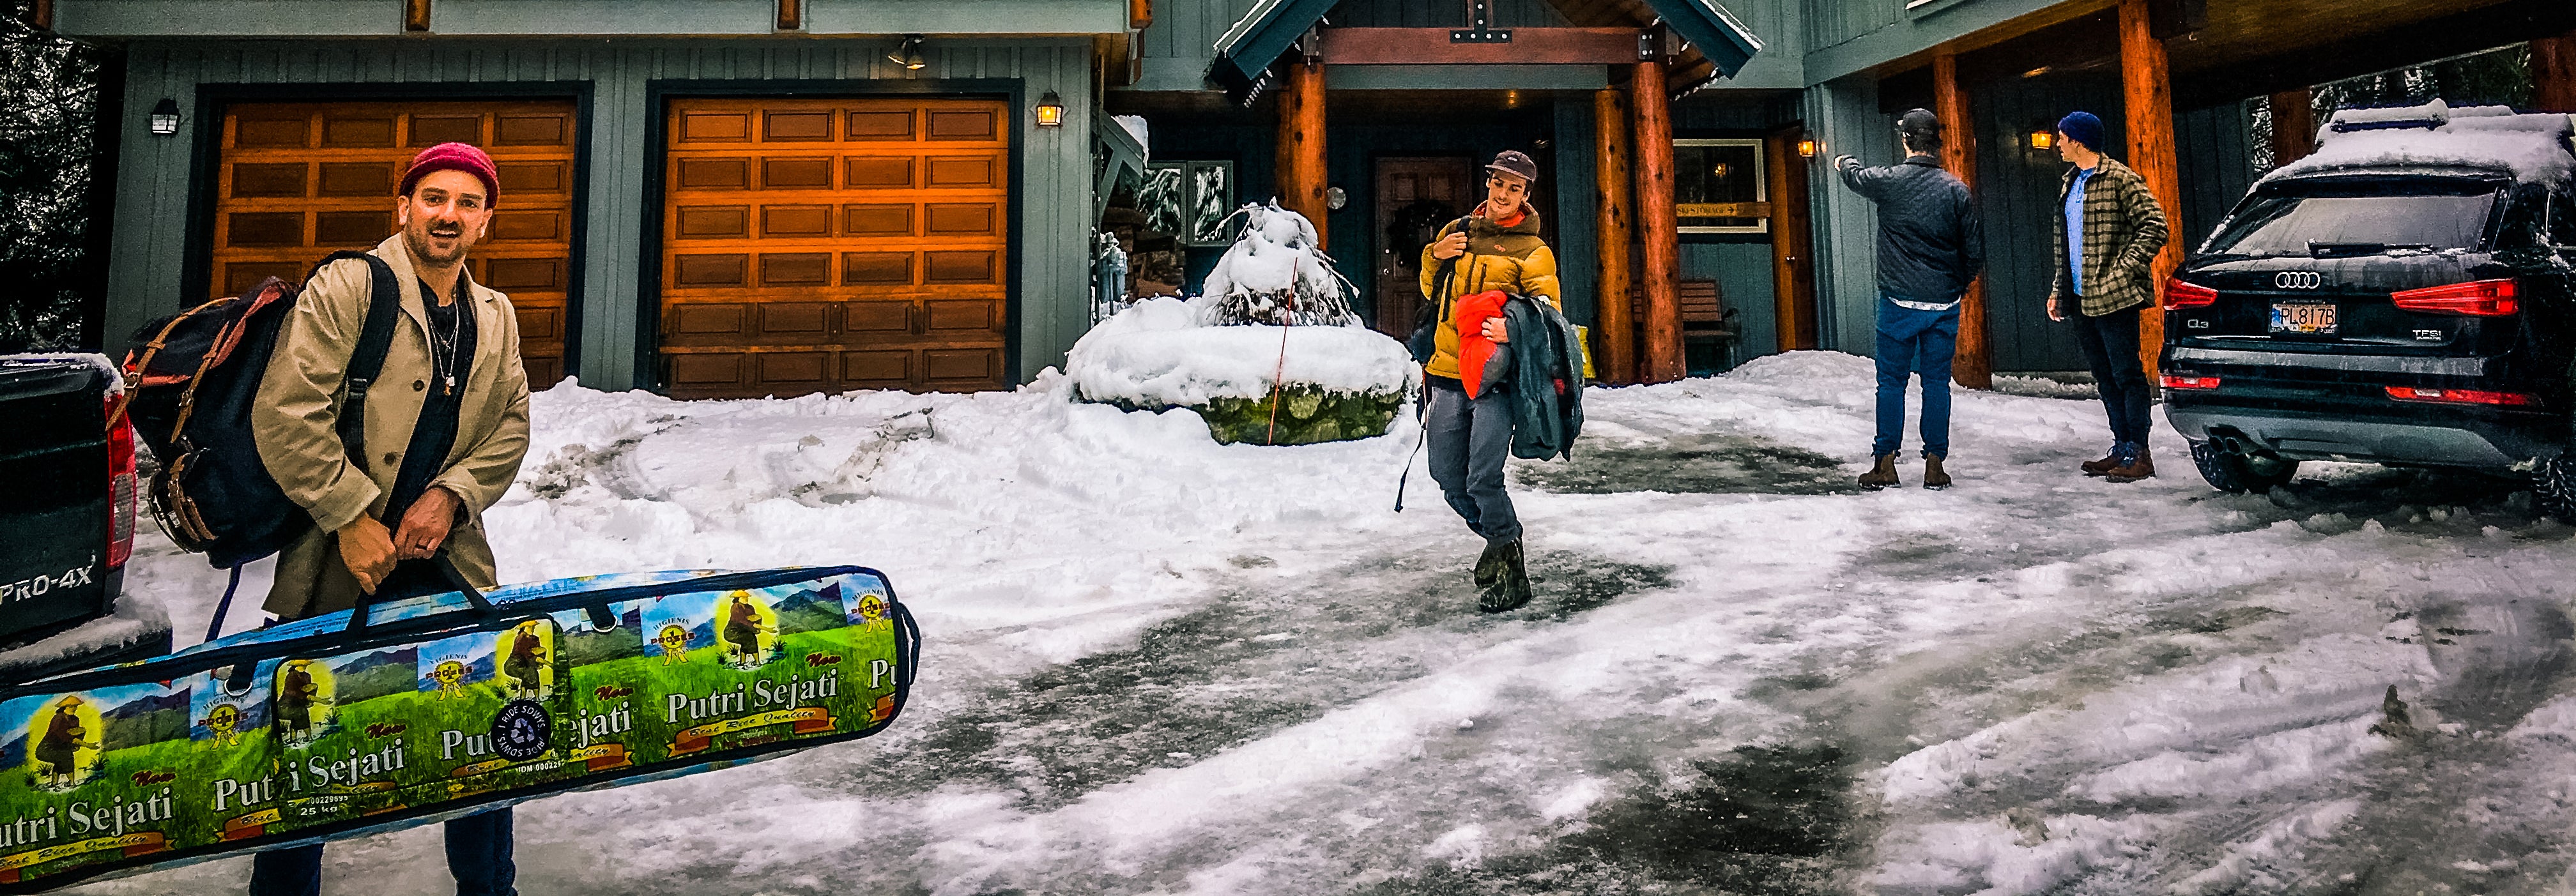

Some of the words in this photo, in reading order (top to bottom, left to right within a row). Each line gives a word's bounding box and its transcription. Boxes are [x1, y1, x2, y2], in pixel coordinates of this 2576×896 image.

[0, 565, 93, 605] PRO-4X
[502, 706, 519, 723] RIDE
[667, 683, 746, 723] Putri
[754, 669, 837, 710] Sejati
[441, 729, 495, 760] Put
[569, 701, 632, 748] ejati
[763, 710, 815, 723] Quality
[308, 738, 404, 787] Sejati
[526, 741, 545, 756] RIDE
[0, 807, 58, 848] utri
[69, 787, 172, 837] Sejati
[300, 807, 316, 816] 25
